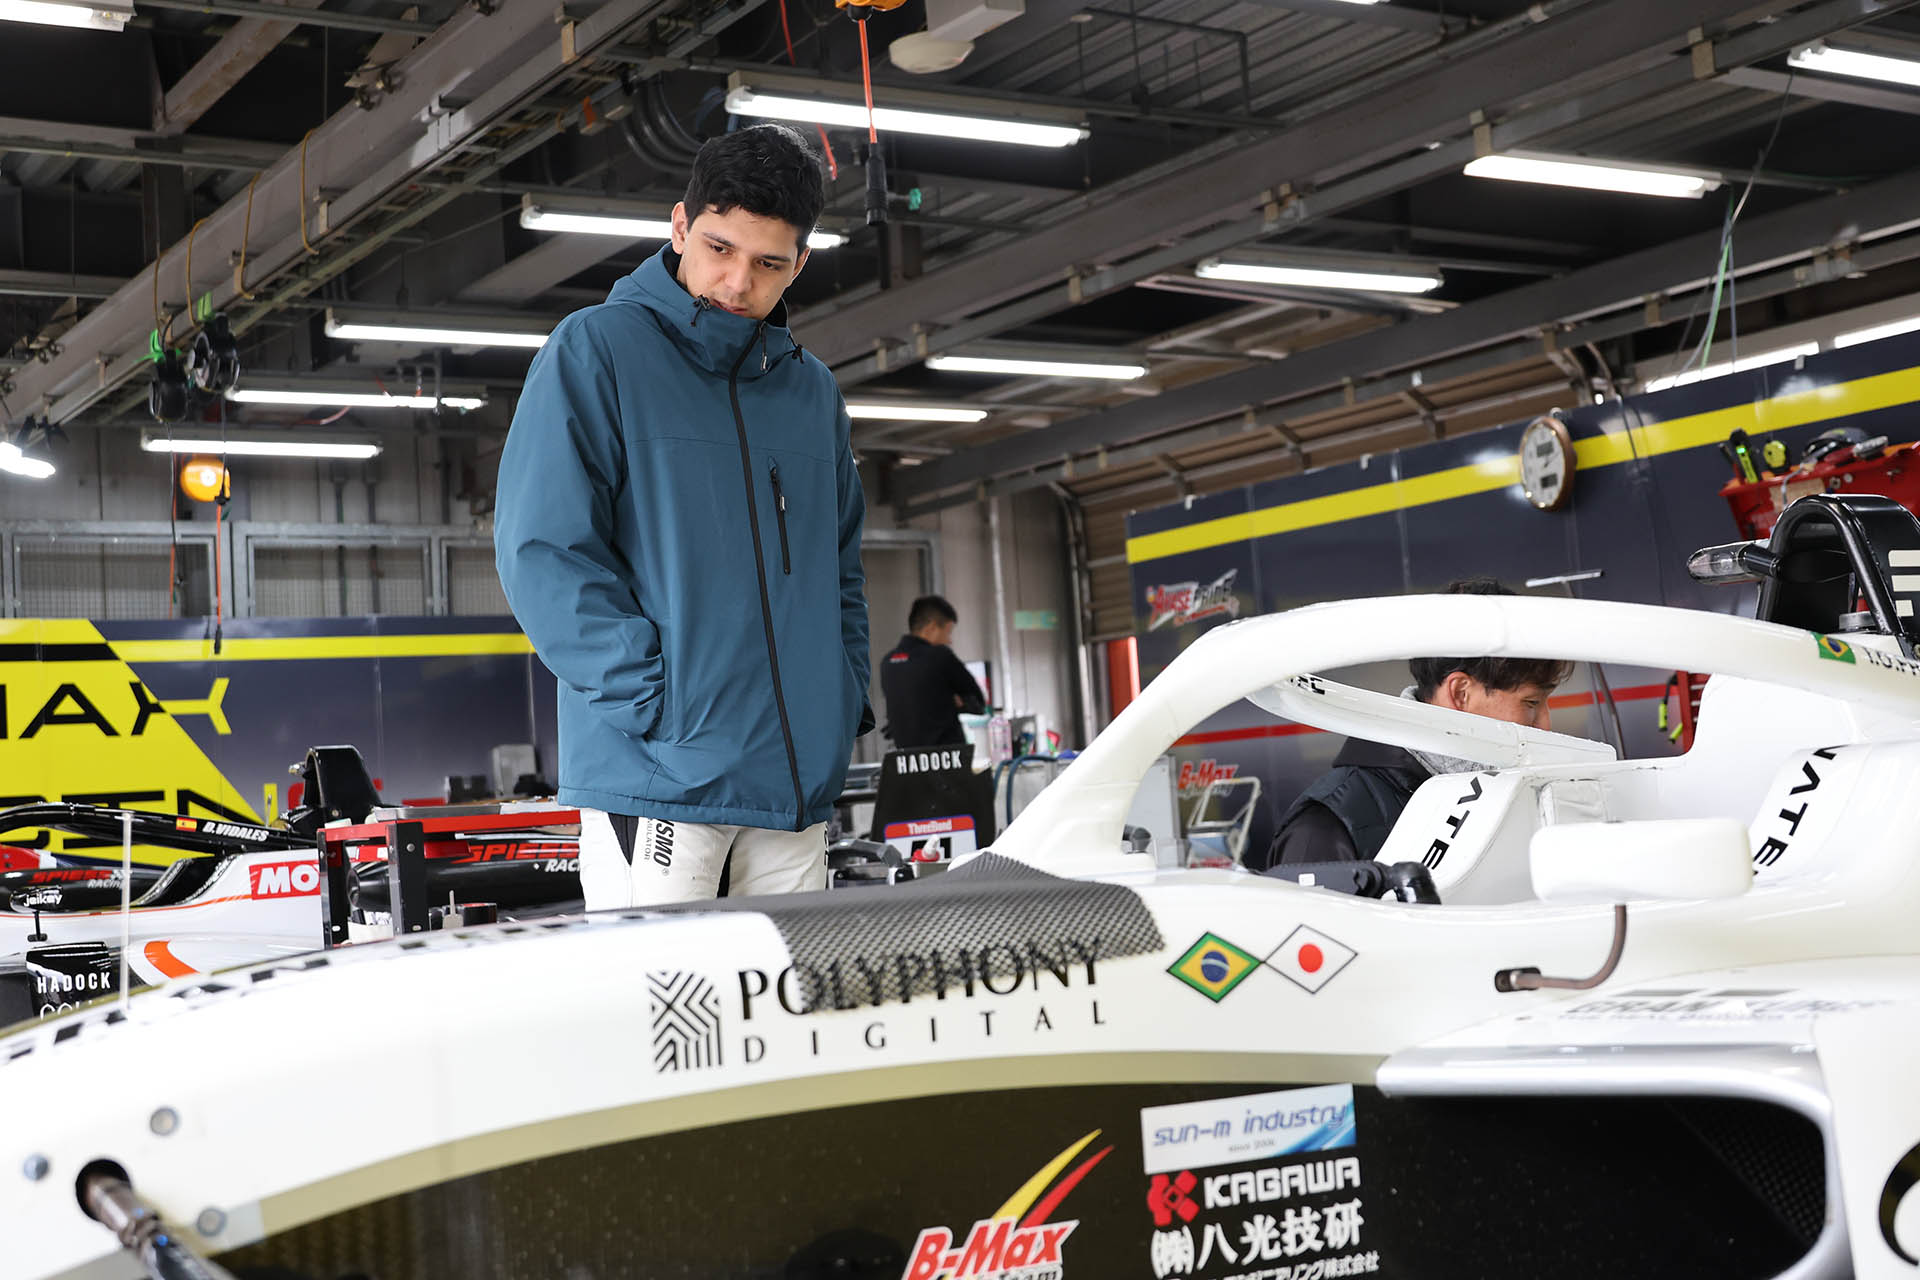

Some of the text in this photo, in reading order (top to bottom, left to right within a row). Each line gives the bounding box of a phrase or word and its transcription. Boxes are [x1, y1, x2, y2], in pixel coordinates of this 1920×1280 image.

[0, 677, 233, 740] AX
[896, 750, 962, 775] HADOCK
[202, 821, 270, 842] D.VIDALES
[256, 863, 321, 895] MO
[36, 971, 111, 994] HADOCK
[744, 1000, 1106, 1064] DIGITAL
[1153, 1103, 1348, 1147] sun-m industry
[1203, 1156, 1362, 1210] KAGAWA
[903, 1218, 1074, 1280] B-Max
